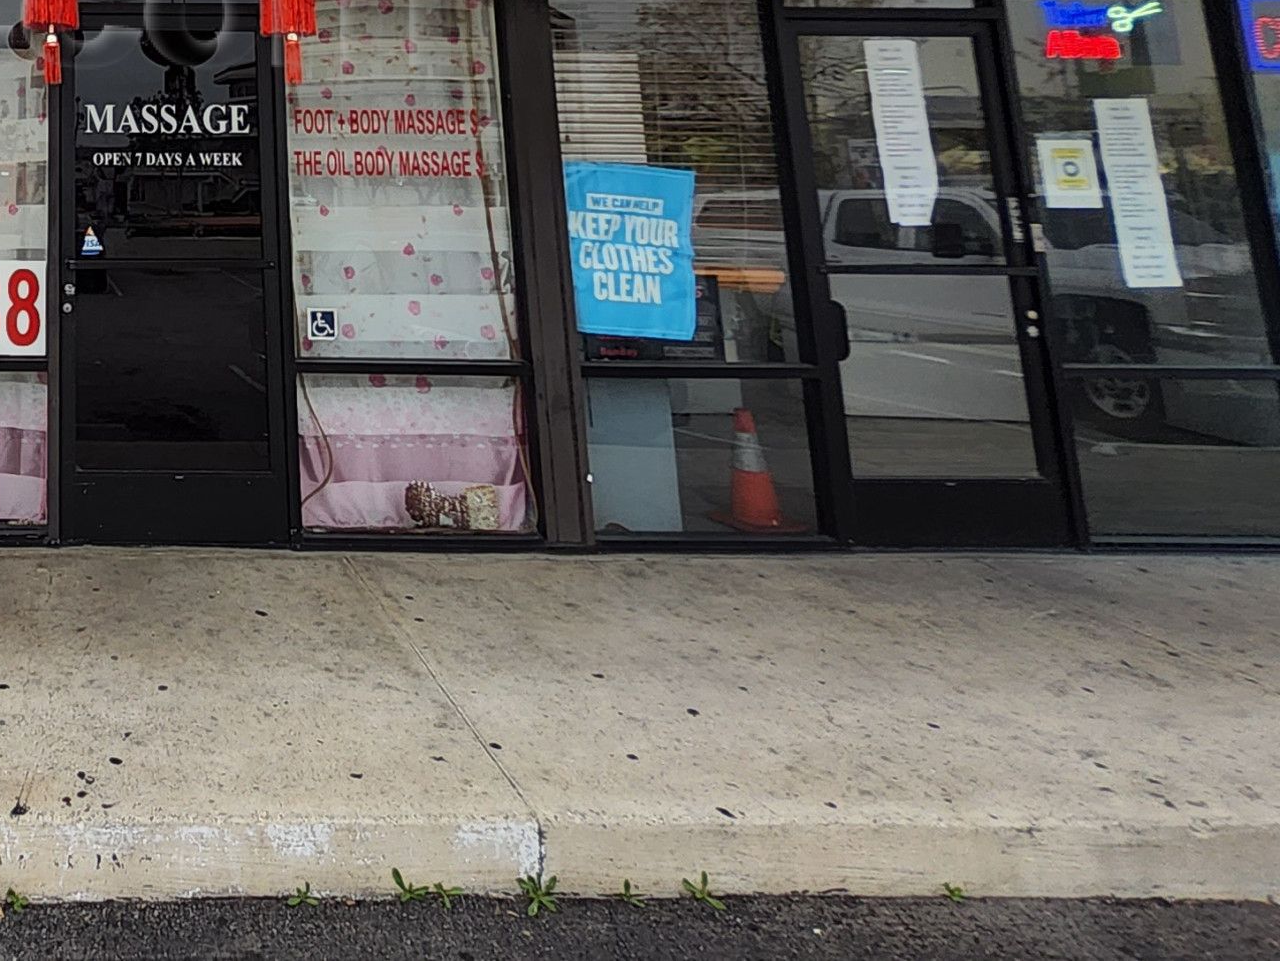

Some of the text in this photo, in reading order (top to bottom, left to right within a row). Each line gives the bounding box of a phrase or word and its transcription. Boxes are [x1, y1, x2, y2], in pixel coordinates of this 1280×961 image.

[84, 104, 251, 134] MASSAGE
[294, 109, 334, 134] FOOT
[349, 109, 390, 134] BODY
[394, 109, 466, 135] MASSAGE
[93, 152, 243, 166] OPEN 7 DAYS A WEEK
[294, 150, 323, 176] THE
[326, 150, 351, 176] OIL
[354, 150, 394, 176] BODY
[399, 150, 472, 177] MASSAGE
[590, 196, 608, 207] WE
[569, 210, 679, 248] KEEP YOUR
[580, 241, 674, 275] CLOTHES
[593, 270, 662, 304] CLEAN
